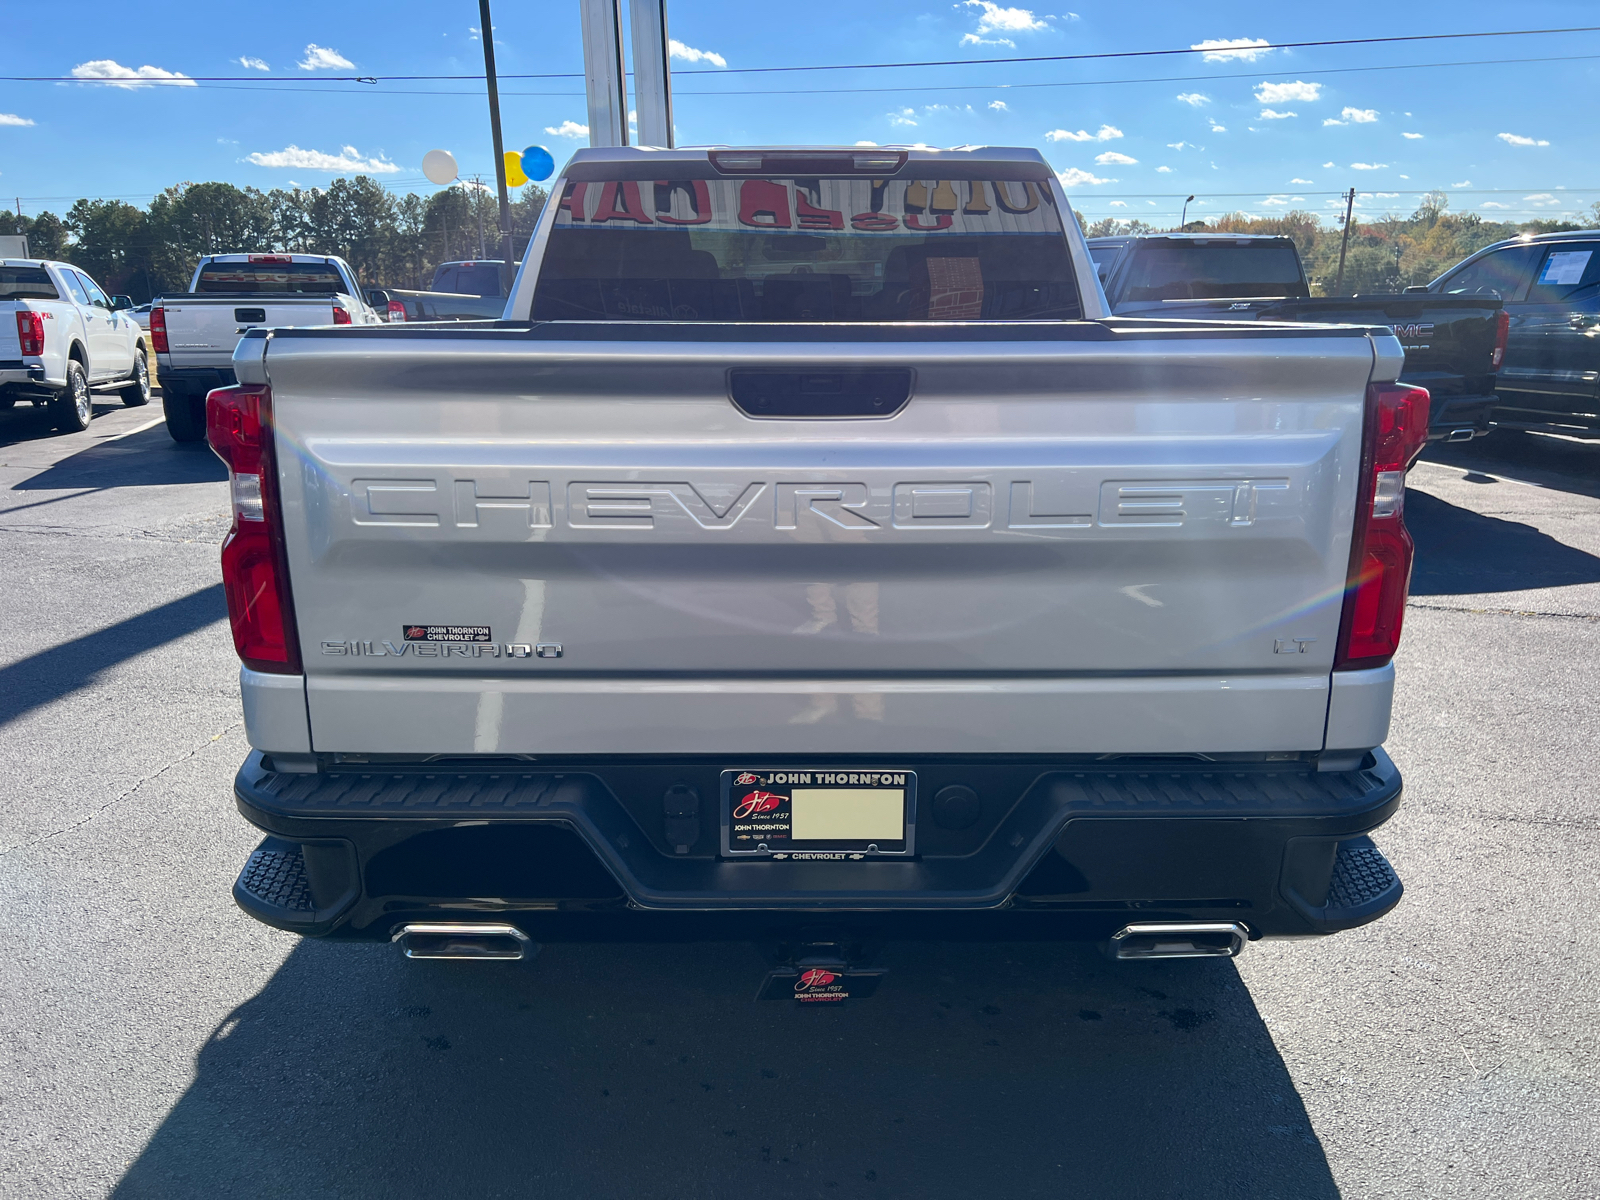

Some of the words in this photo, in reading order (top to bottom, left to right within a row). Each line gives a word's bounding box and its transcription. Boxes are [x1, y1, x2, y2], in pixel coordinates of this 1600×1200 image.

[1388, 323, 1434, 338] MC
[351, 476, 1289, 531] CHEVROLET
[427, 626, 447, 634] JOHN
[447, 627, 489, 635] THORNTON
[427, 633, 475, 641] CHEVROLET
[321, 640, 564, 658] SILVERADO
[1273, 637, 1318, 654] LT
[767, 773, 812, 784] JOHN
[815, 773, 905, 785] THORNTON
[771, 812, 790, 820] 1957
[752, 823, 790, 831] THORNTON
